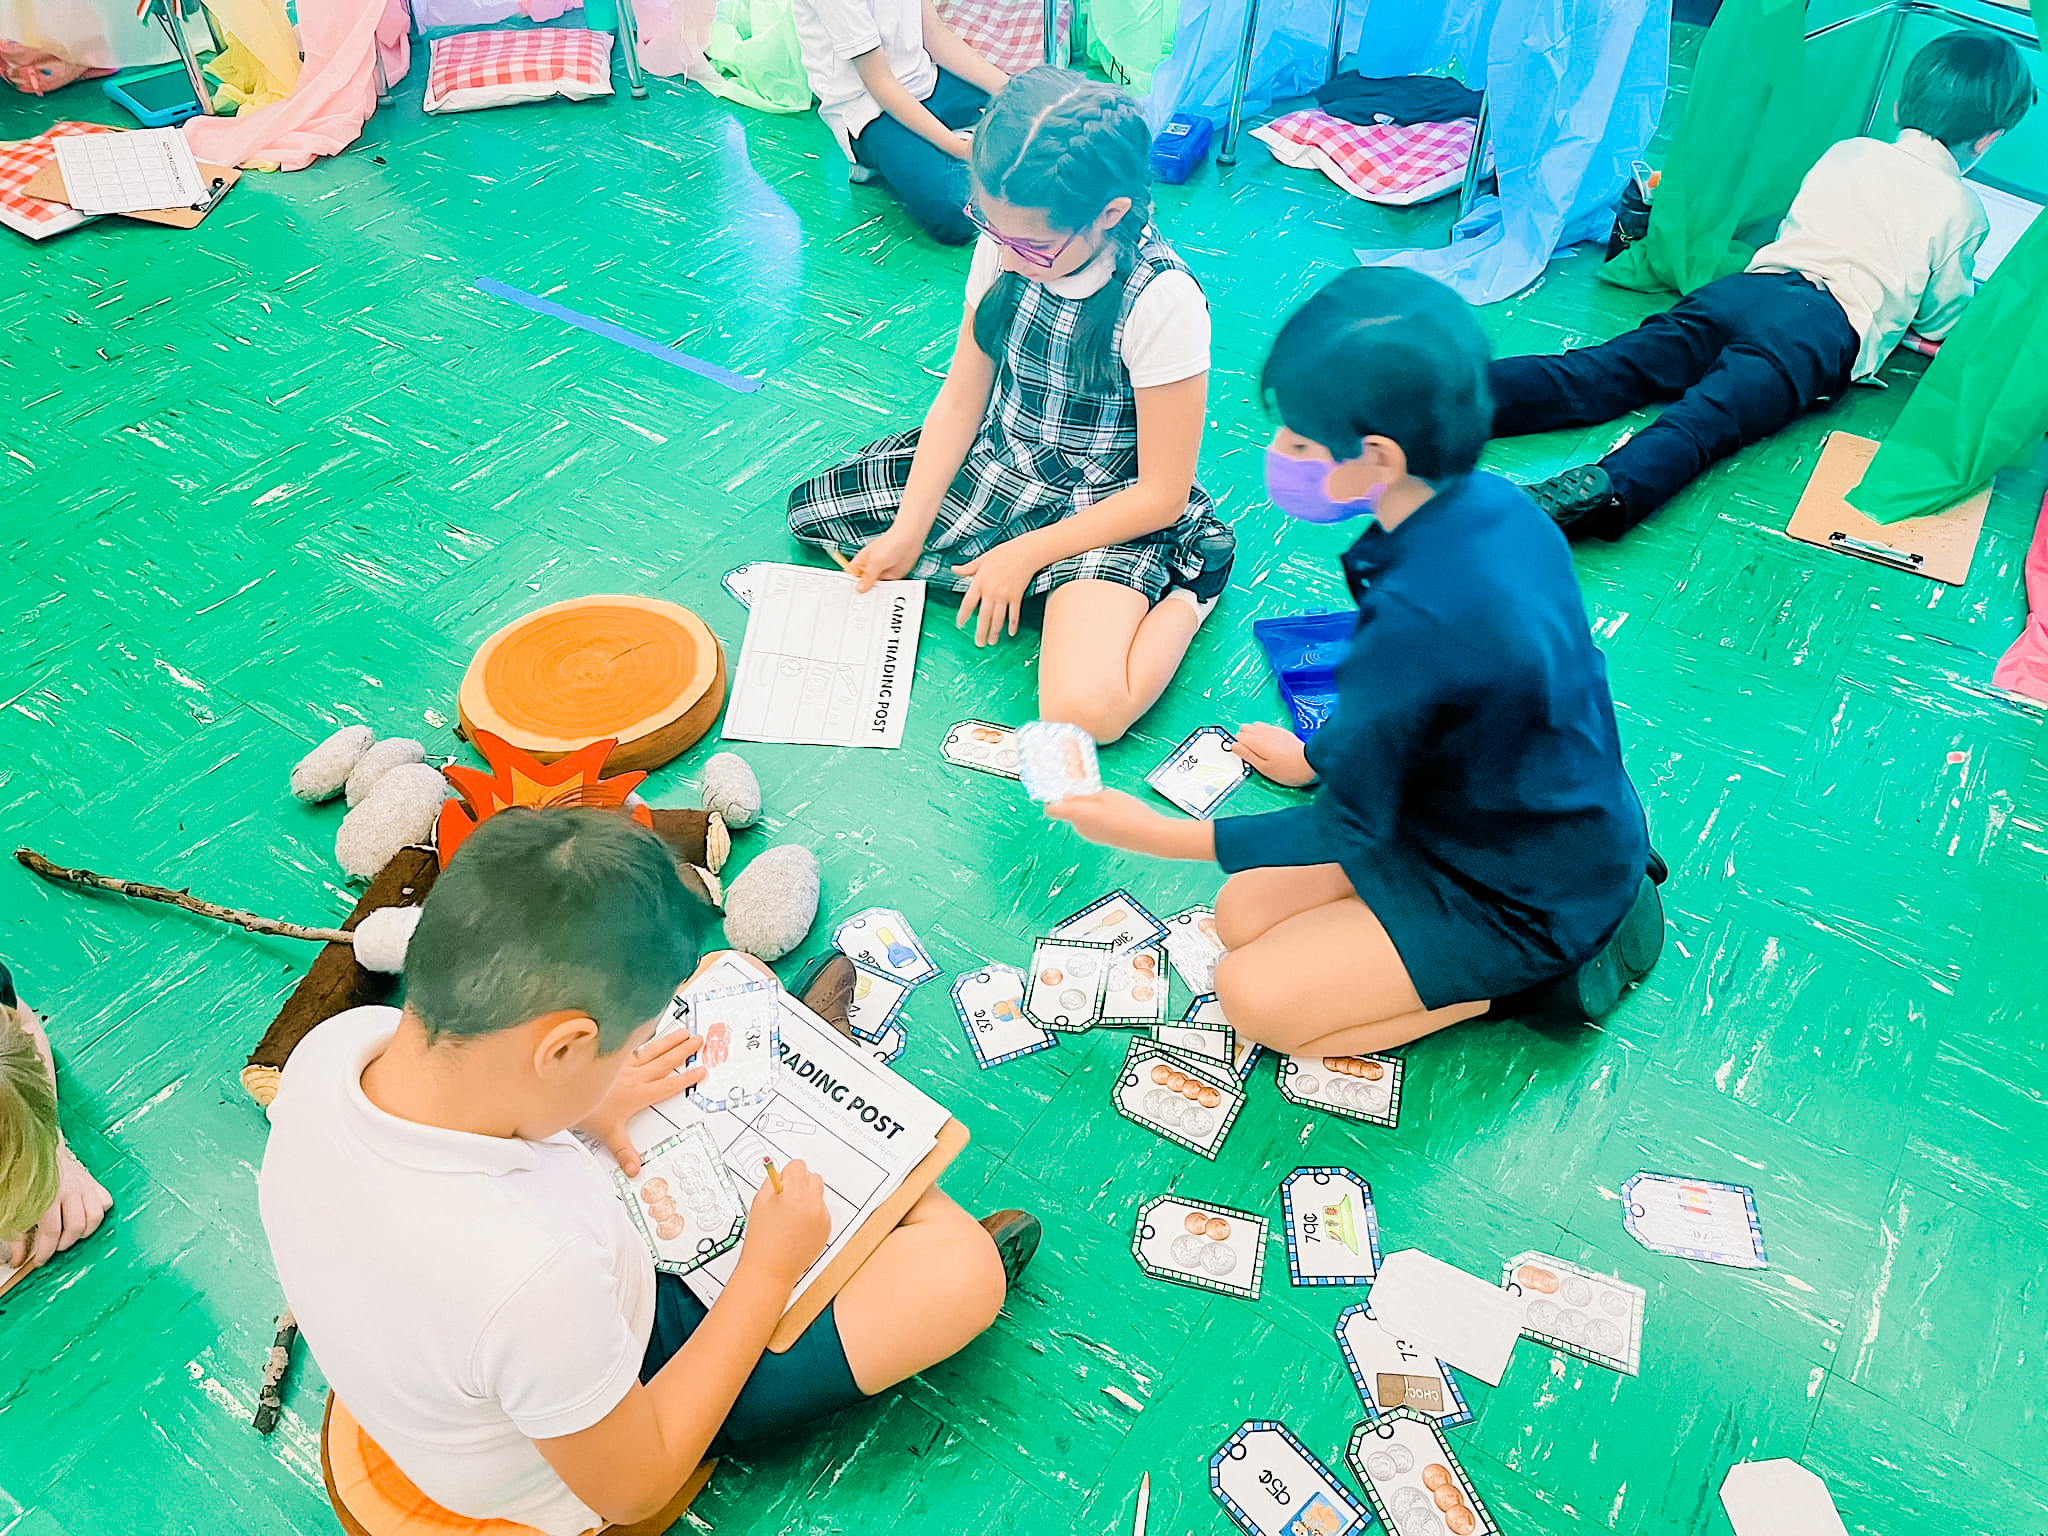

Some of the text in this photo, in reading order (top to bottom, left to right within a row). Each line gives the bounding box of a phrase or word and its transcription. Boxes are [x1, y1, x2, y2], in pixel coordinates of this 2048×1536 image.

[871, 596, 906, 733] CAMP TRADING POST
[1177, 754, 1199, 775] 92¢
[974, 1009, 994, 1033] 37¢
[778, 1039, 905, 1140] RADING POST
[1303, 1213, 1321, 1244] 79¢
[1259, 1469, 1291, 1506] 95¢
